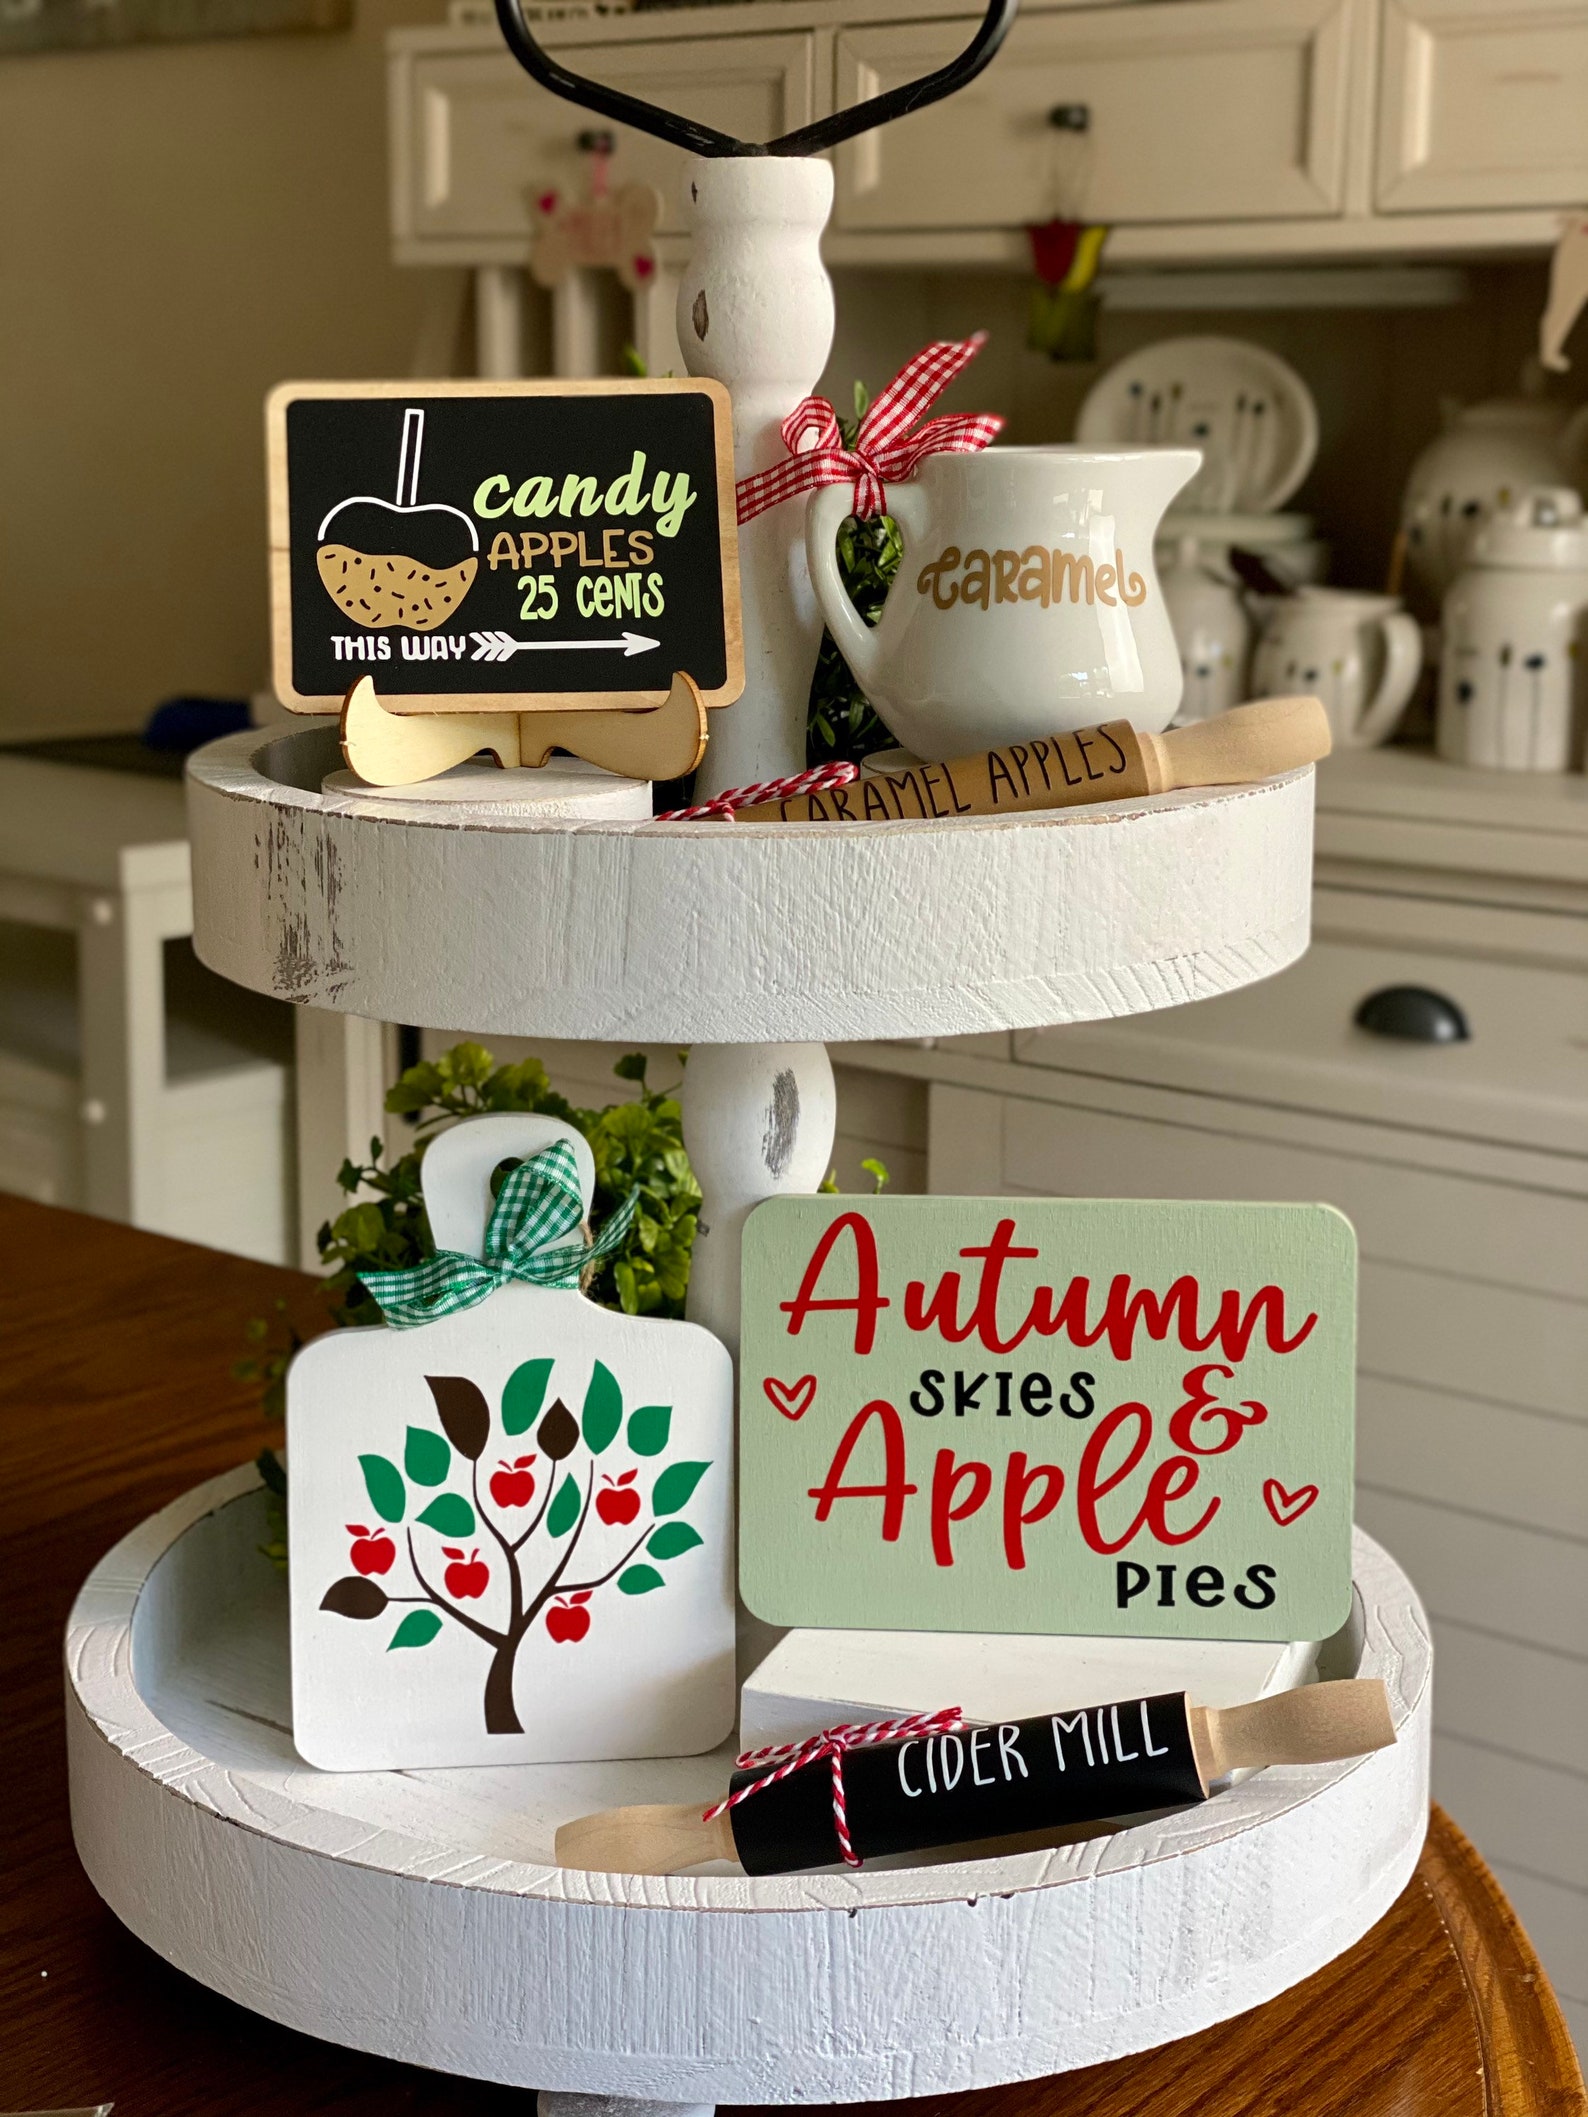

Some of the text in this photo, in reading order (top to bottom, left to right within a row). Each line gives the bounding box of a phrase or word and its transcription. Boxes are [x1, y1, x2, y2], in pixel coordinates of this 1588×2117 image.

[473, 450, 697, 537] candy
[487, 529, 654, 570] APPLES
[517, 575, 559, 620] 25
[330, 635, 466, 661] THIS WAY
[987, 723, 1127, 804] APPLES
[780, 1212, 1318, 1362] Autumn
[1169, 1364, 1268, 1455] &
[808, 1400, 1221, 1570] Apple
[898, 1700, 1169, 1798] CIDER MILL
